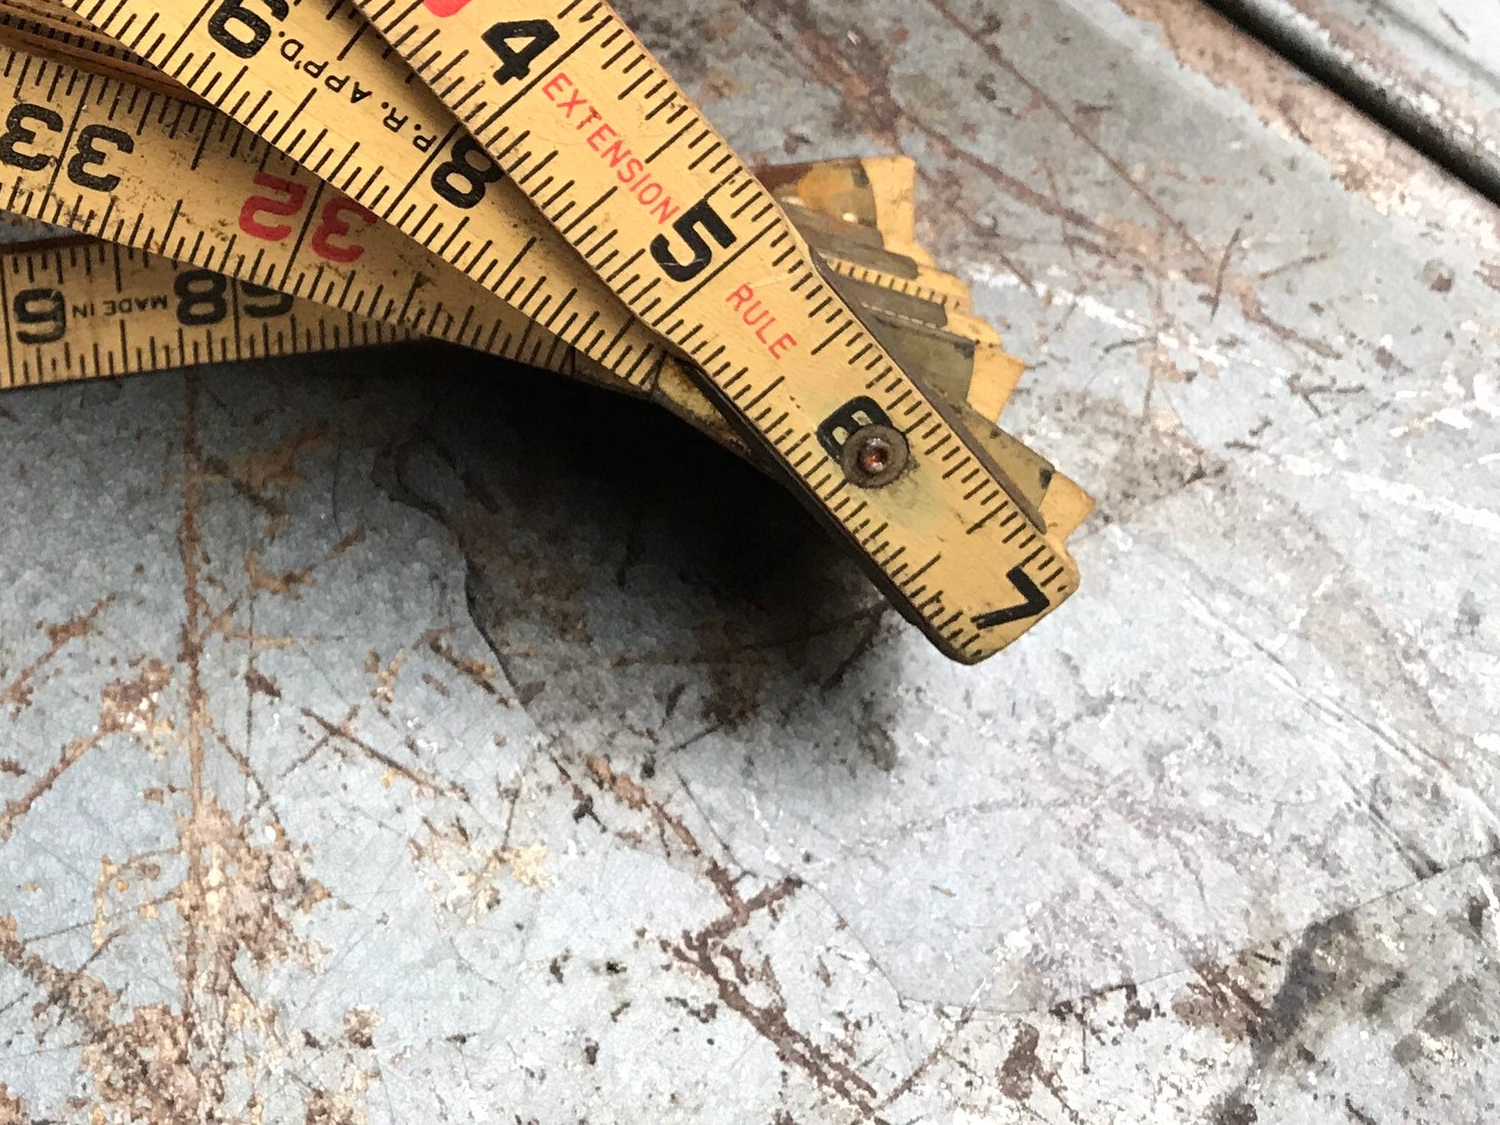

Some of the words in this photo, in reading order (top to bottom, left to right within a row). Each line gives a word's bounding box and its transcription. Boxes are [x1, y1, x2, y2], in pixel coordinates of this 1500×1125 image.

[480, 19, 561, 86] 4
[430, 135, 504, 210] 8
[541, 72, 681, 225] EXTENSION
[238, 171, 378, 264] 32
[650, 197, 738, 283] 5
[71, 301, 95, 319] IN
[103, 294, 169, 317] MADE
[725, 282, 798, 361] RULE
[969, 565, 1051, 630] 7
